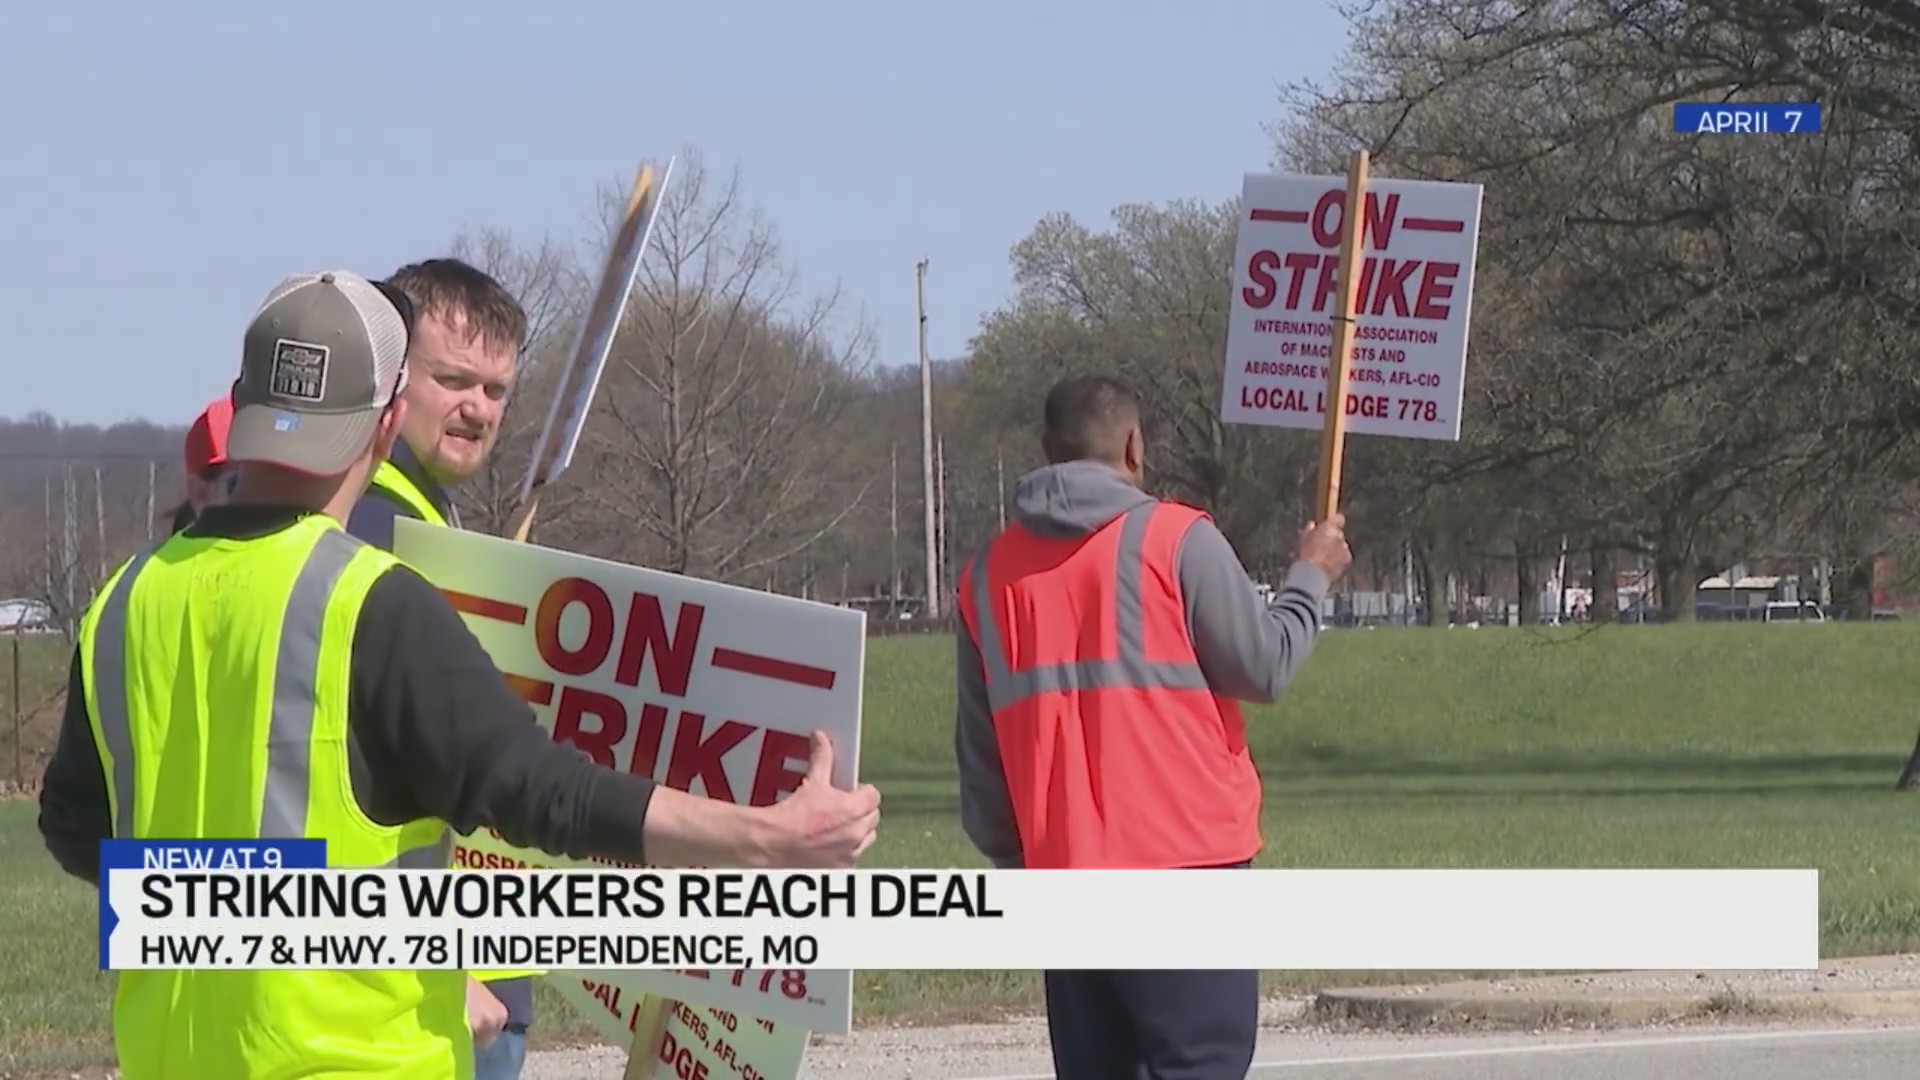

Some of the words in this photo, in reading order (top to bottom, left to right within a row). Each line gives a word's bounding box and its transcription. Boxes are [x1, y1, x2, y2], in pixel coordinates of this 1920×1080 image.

[1311, 189, 1400, 250] ON
[1254, 319, 1333, 337] INTERNATION
[1353, 327, 1438, 344] ASSOCIATION
[1281, 342, 1296, 356] OF
[1379, 349, 1406, 363] AND
[1244, 360, 1318, 379] AEROSPACE
[1389, 371, 1441, 388] AFL-CIO
[1241, 386, 1309, 412] LOCAL
[1316, 391, 1389, 419] LDGE
[1398, 399, 1437, 422] 778
[534, 576, 706, 698] ON
